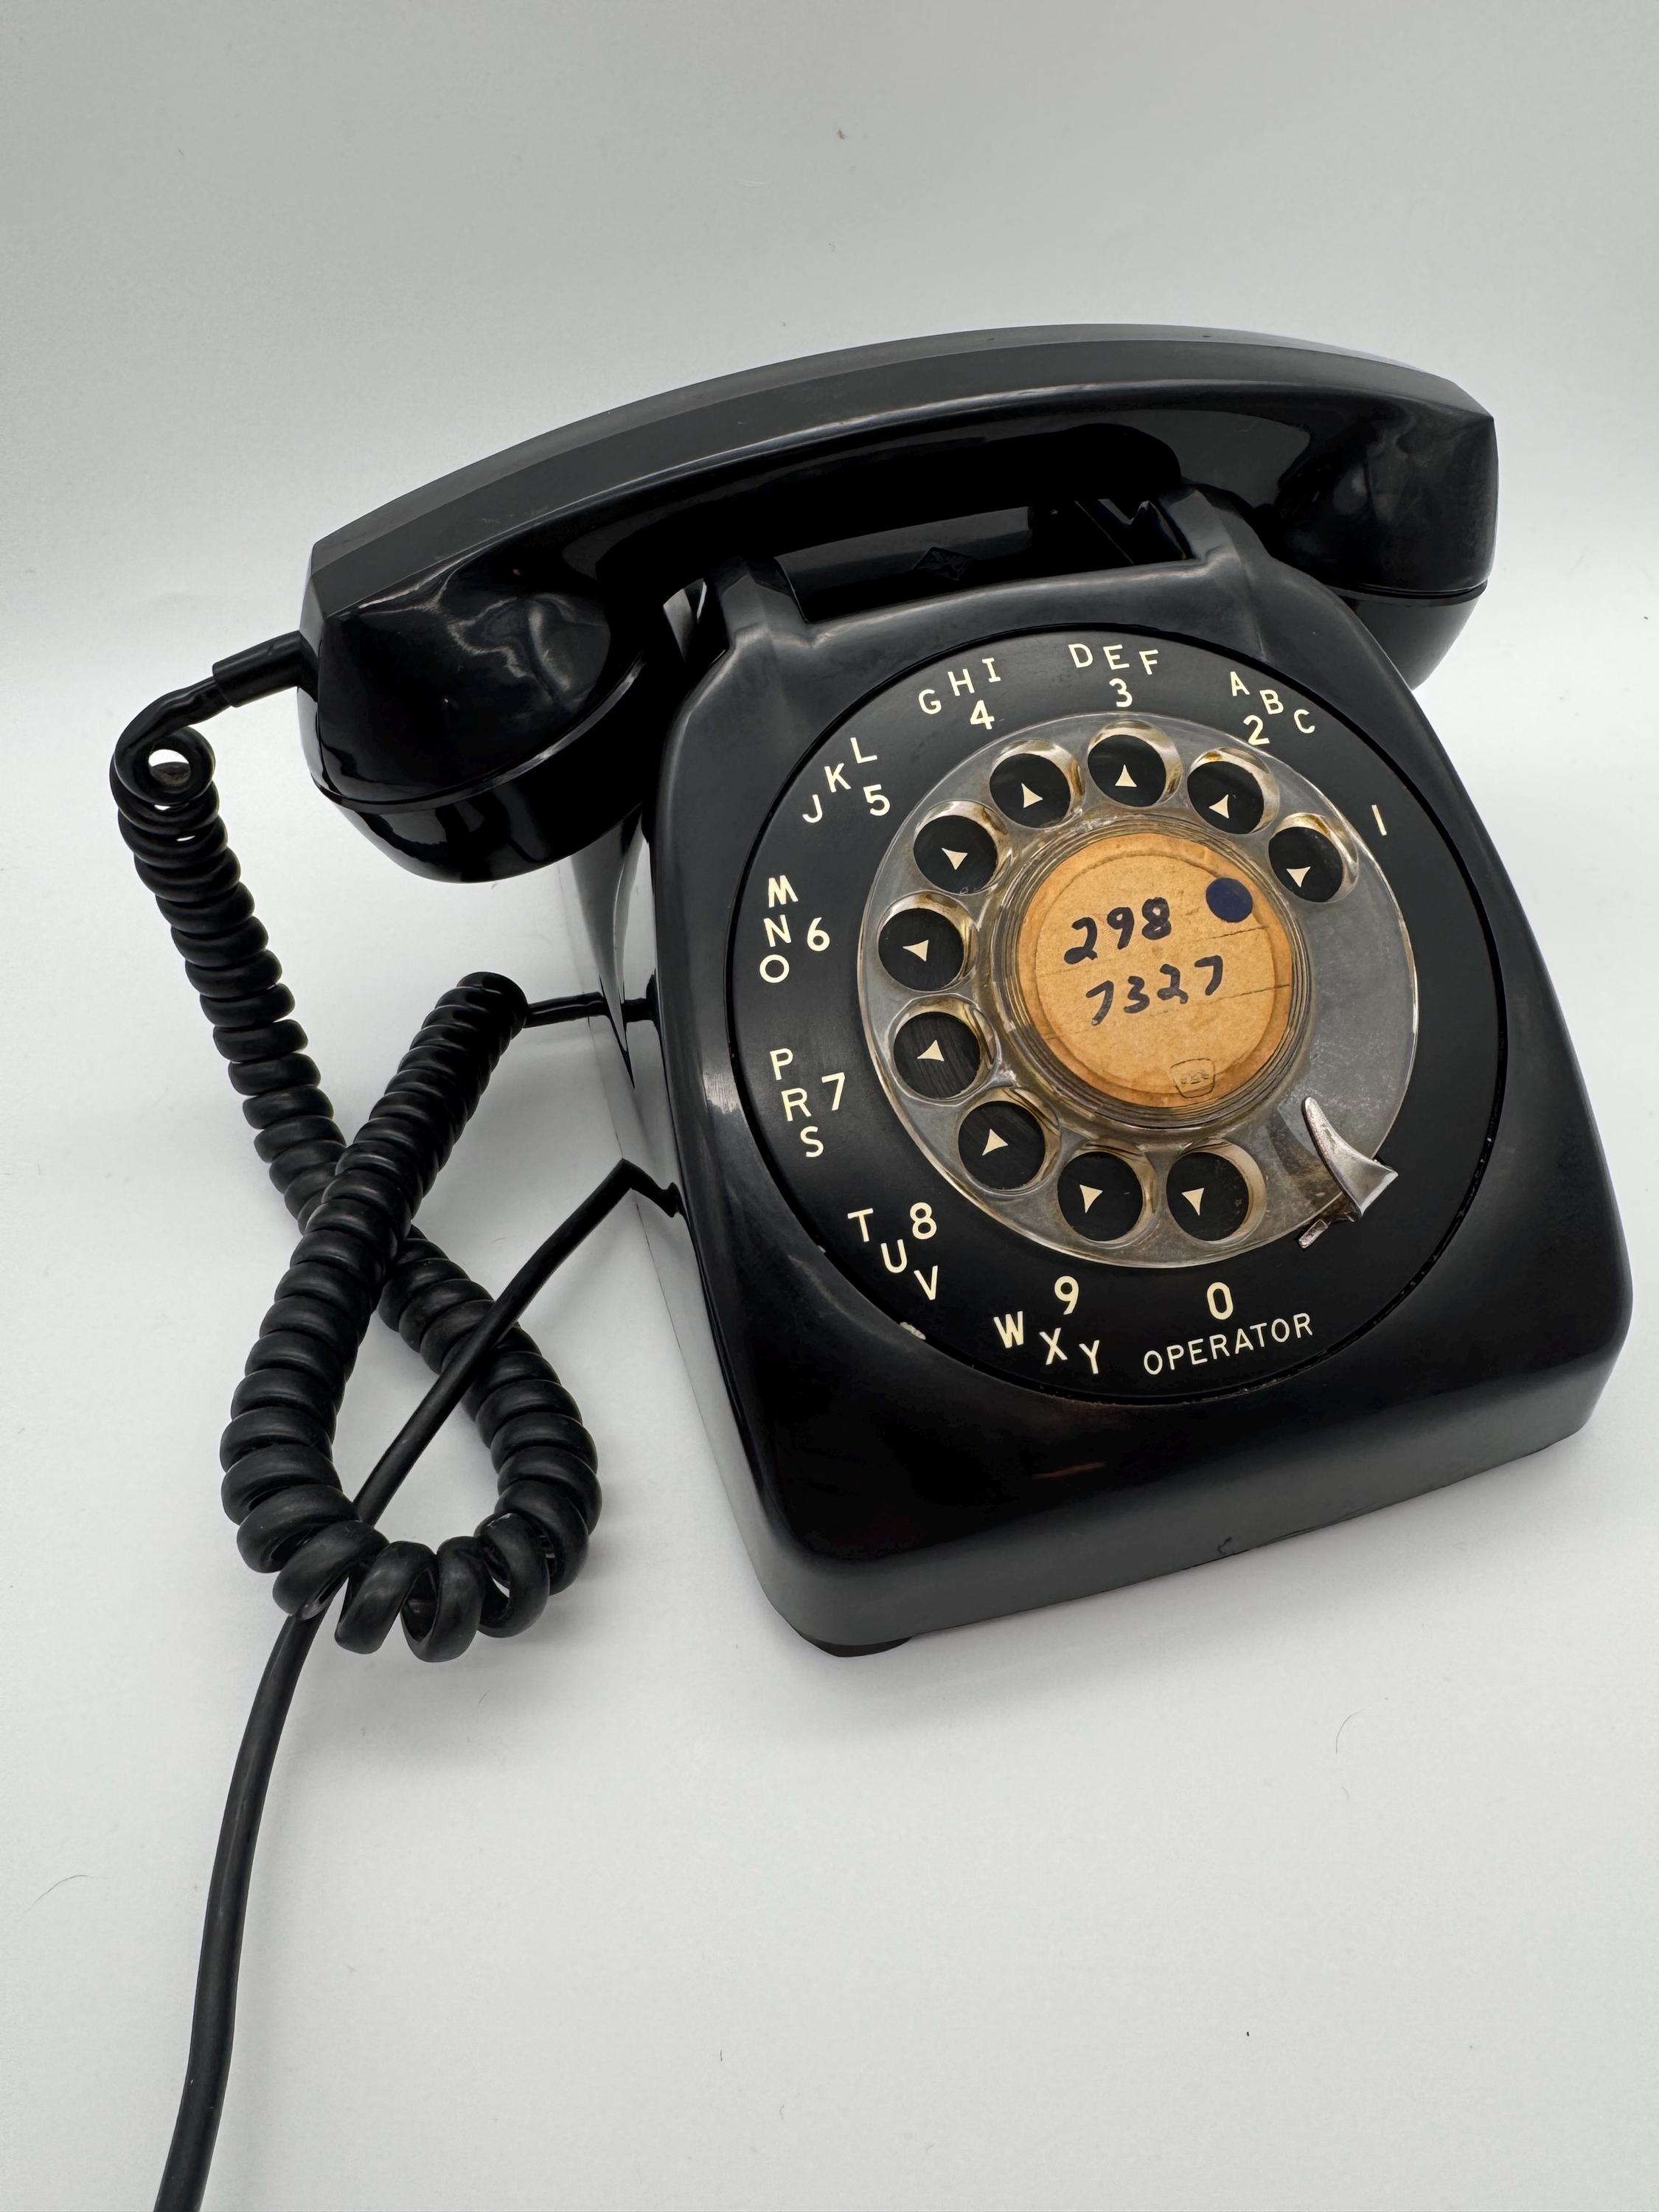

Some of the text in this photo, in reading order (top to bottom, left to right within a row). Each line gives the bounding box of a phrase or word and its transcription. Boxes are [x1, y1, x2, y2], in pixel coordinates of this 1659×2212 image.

[1066, 642, 1160, 676] DEF
[1107, 677, 1134, 709] 3
[1229, 670, 1316, 734] ABC
[969, 698, 996, 731] 4
[1242, 714, 1271, 747] 2
[862, 782, 891, 817] 5
[806, 916, 831, 953] 6
[1062, 896, 1172, 966] 298
[1085, 954, 1224, 1027] 7327
[820, 1071, 846, 1112] 7
[908, 1201, 938, 1241] 8
[1053, 1275, 1080, 1316] 9
[1206, 1281, 1234, 1321] 0
[1143, 1312, 1313, 1376] OPERATOR
